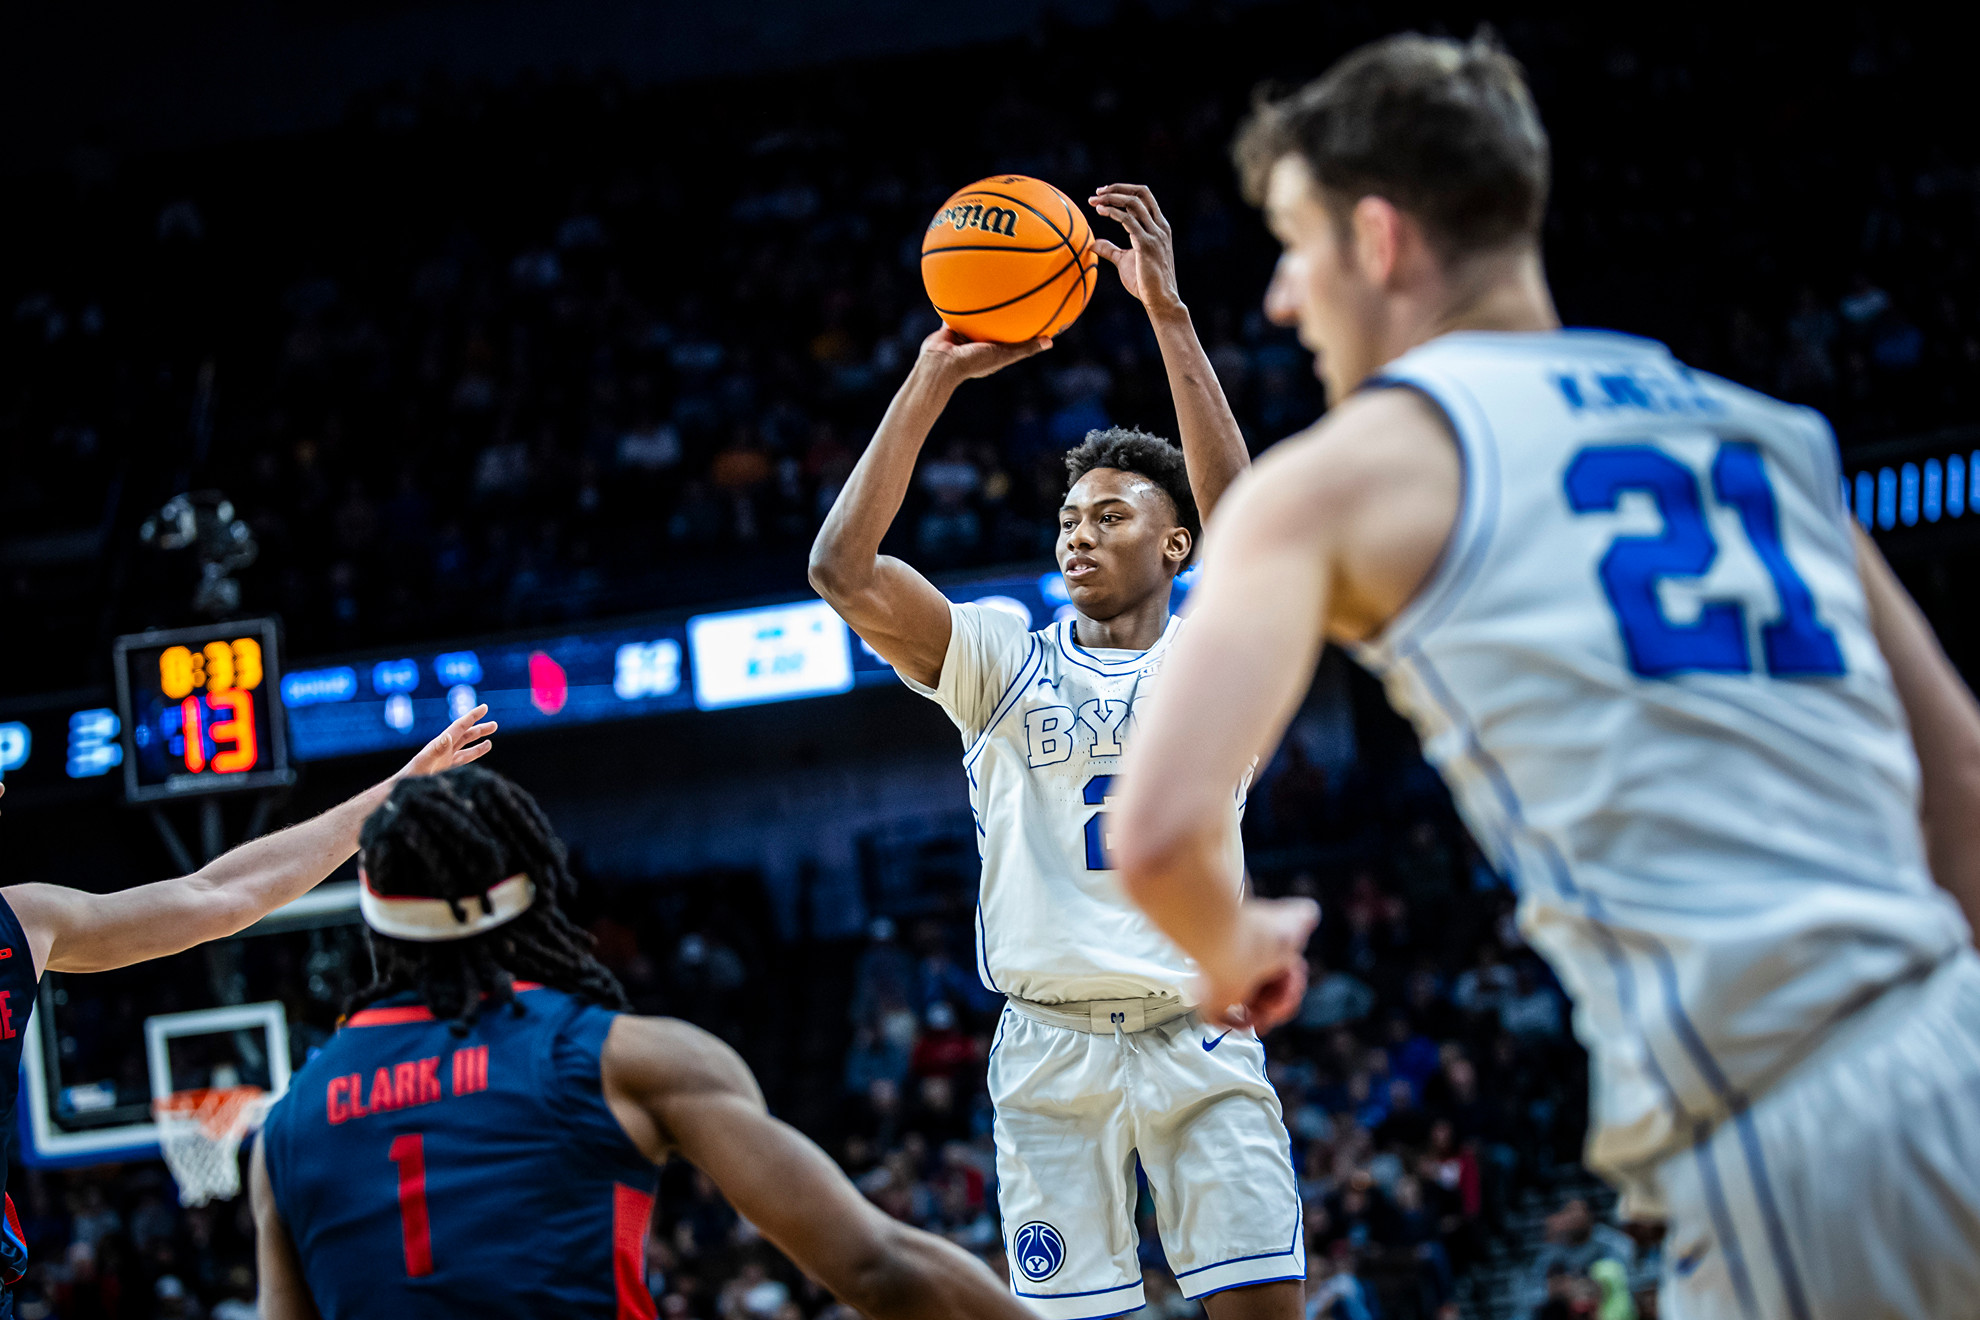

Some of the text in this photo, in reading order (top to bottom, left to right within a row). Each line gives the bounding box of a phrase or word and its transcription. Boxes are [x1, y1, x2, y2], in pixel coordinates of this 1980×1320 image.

[1563, 440, 1846, 680] 21
[181, 686, 259, 774] 13
[1024, 698, 1146, 769] BY
[327, 1045, 489, 1125] CLARK III
[389, 1133, 434, 1278] 1
